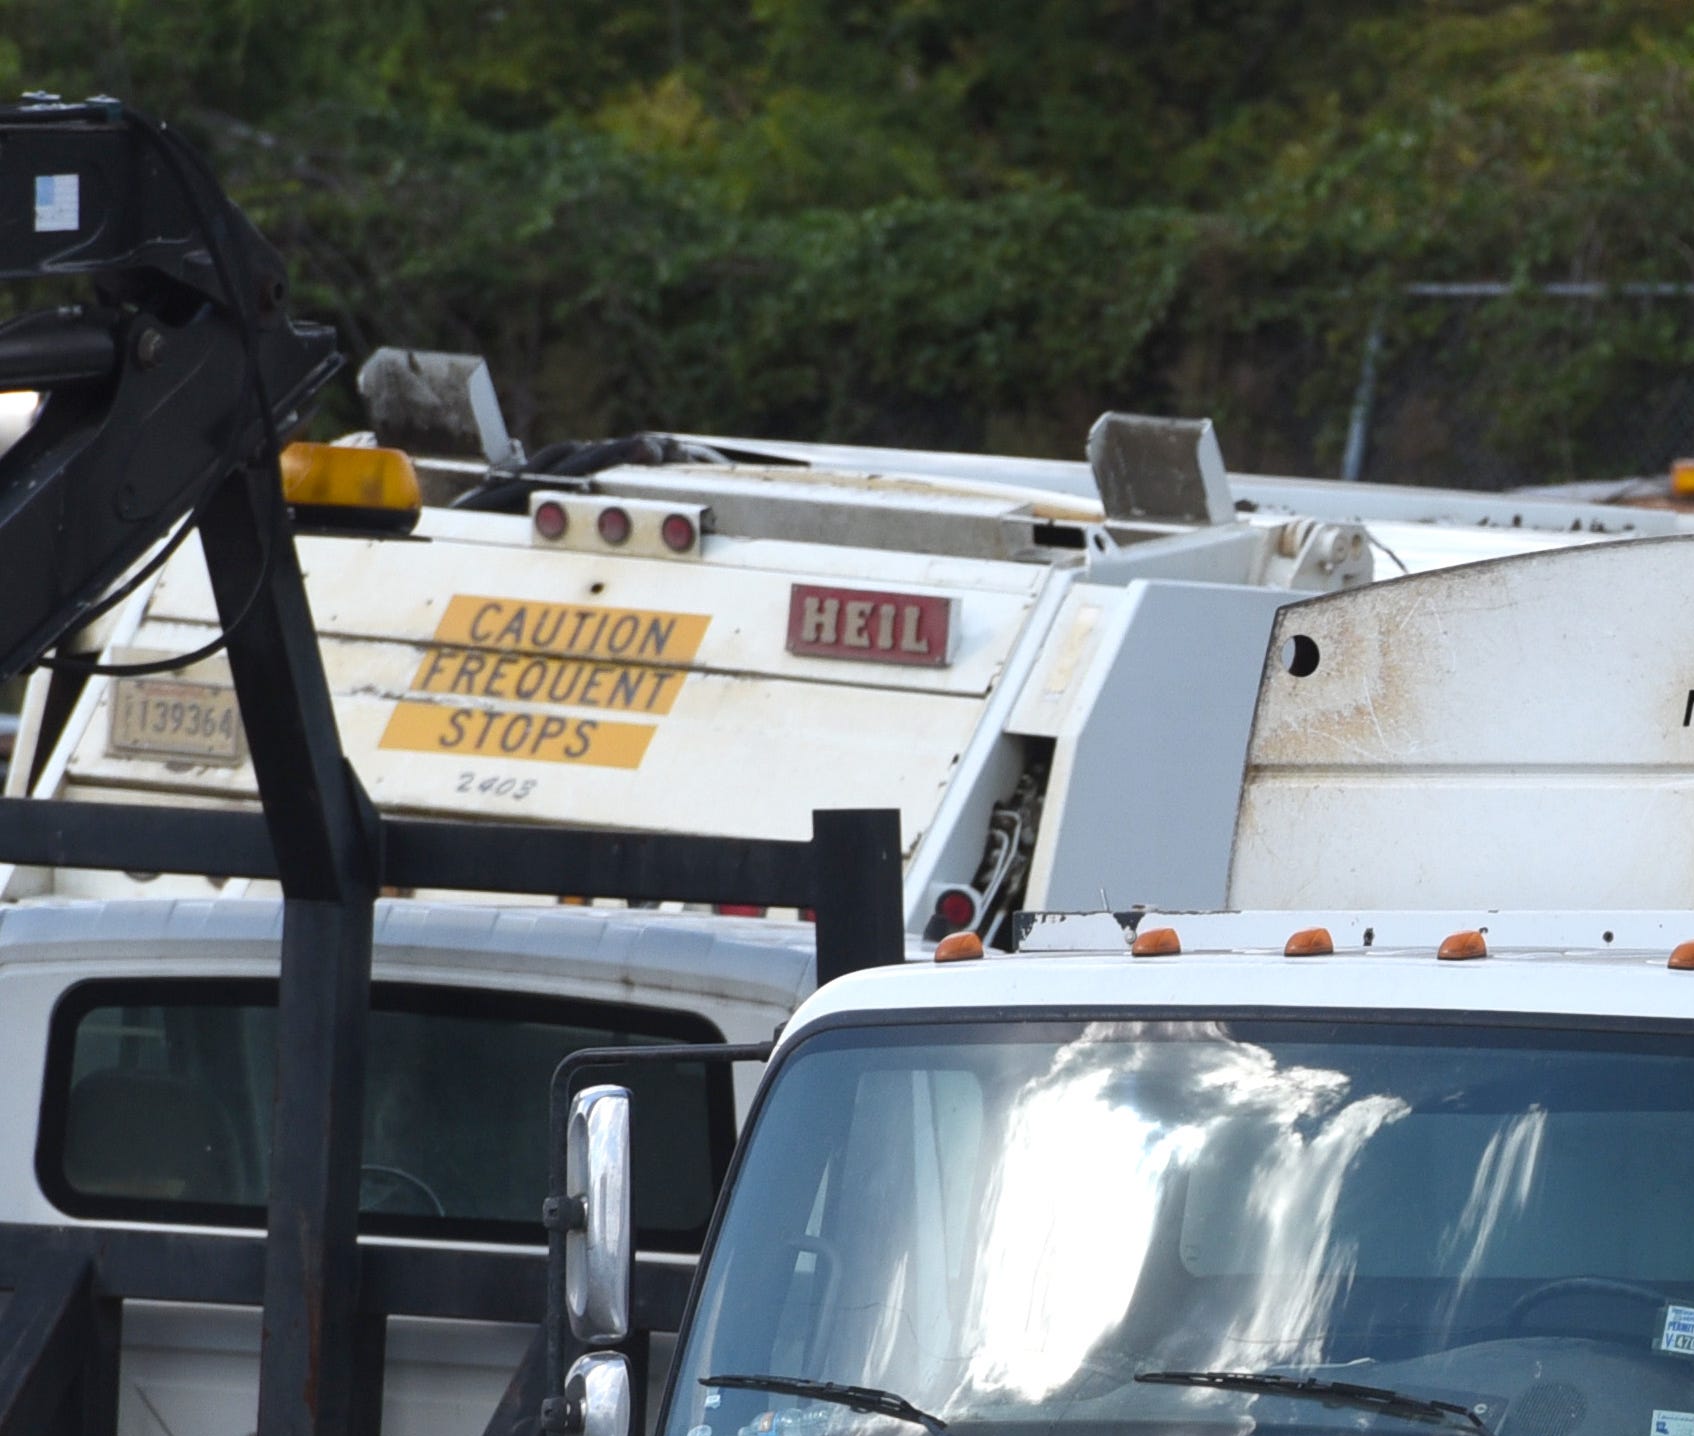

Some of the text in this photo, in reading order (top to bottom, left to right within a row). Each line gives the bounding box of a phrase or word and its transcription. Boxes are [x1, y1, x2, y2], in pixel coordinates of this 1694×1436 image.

[469, 603, 676, 655] CAUTION
[803, 597, 929, 653] HEIL
[421, 650, 674, 709] FREQUENT
[439, 708, 598, 758] STOPS
